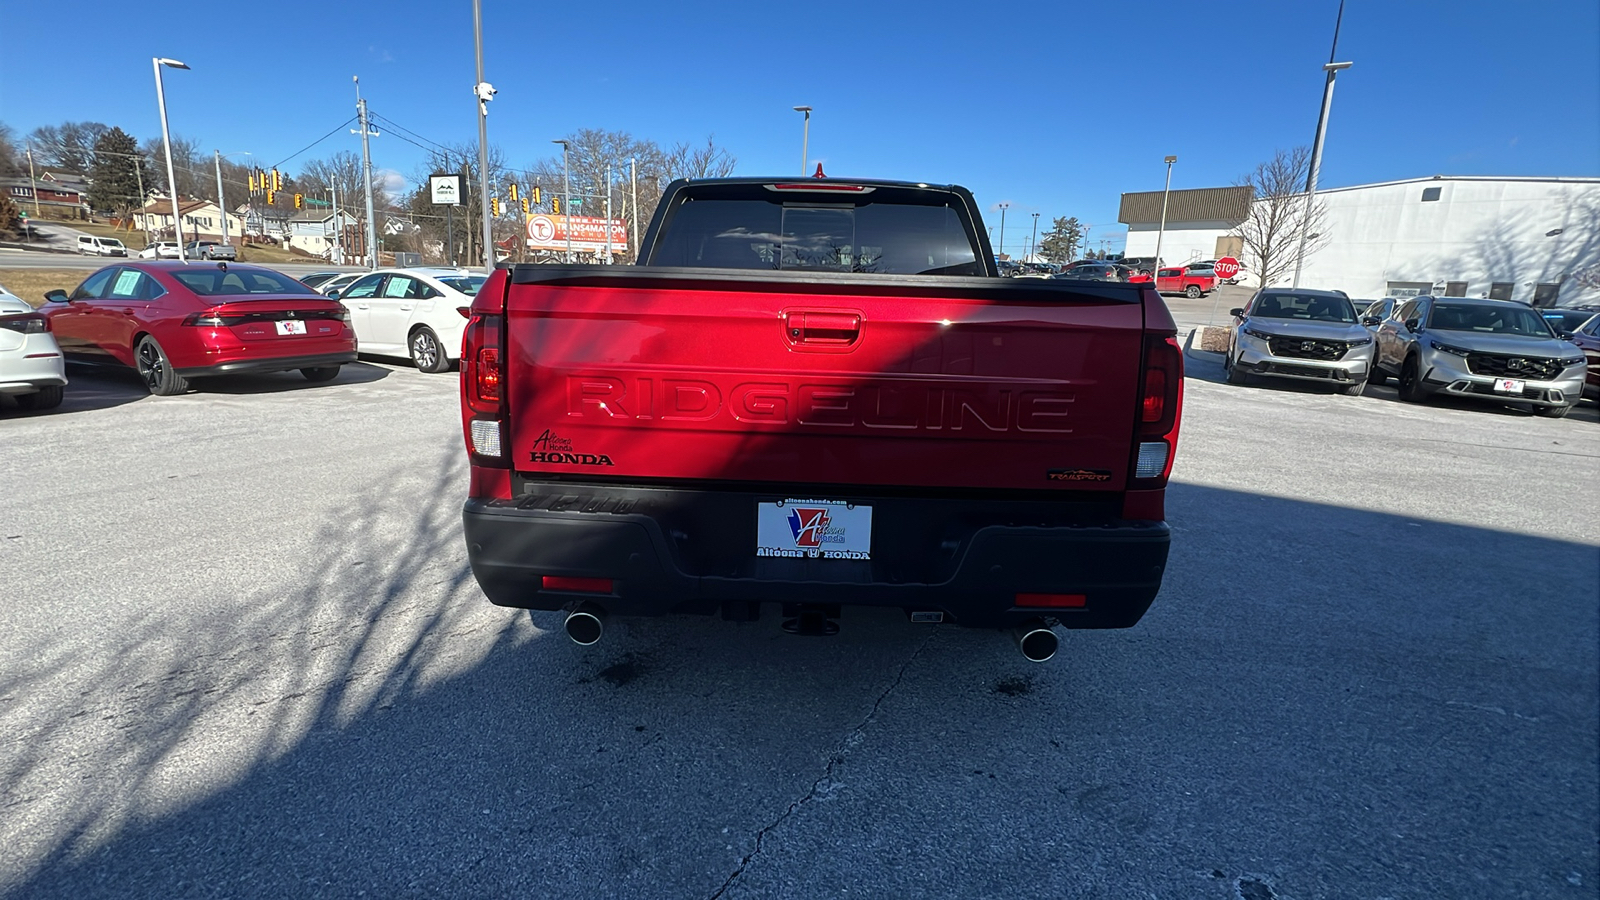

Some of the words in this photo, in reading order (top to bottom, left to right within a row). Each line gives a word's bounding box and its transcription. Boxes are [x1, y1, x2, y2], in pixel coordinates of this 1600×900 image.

[556, 222, 625, 234] TRANS4MATON
[1215, 262, 1238, 274] STOP
[567, 373, 1076, 433] RIDGELINE
[549, 443, 573, 452] Honda
[529, 451, 615, 466] HONDA
[784, 497, 847, 505] altoonahonda.com
[816, 534, 846, 543] Honda
[756, 547, 804, 558] Altoona
[823, 551, 871, 560] HONDA
